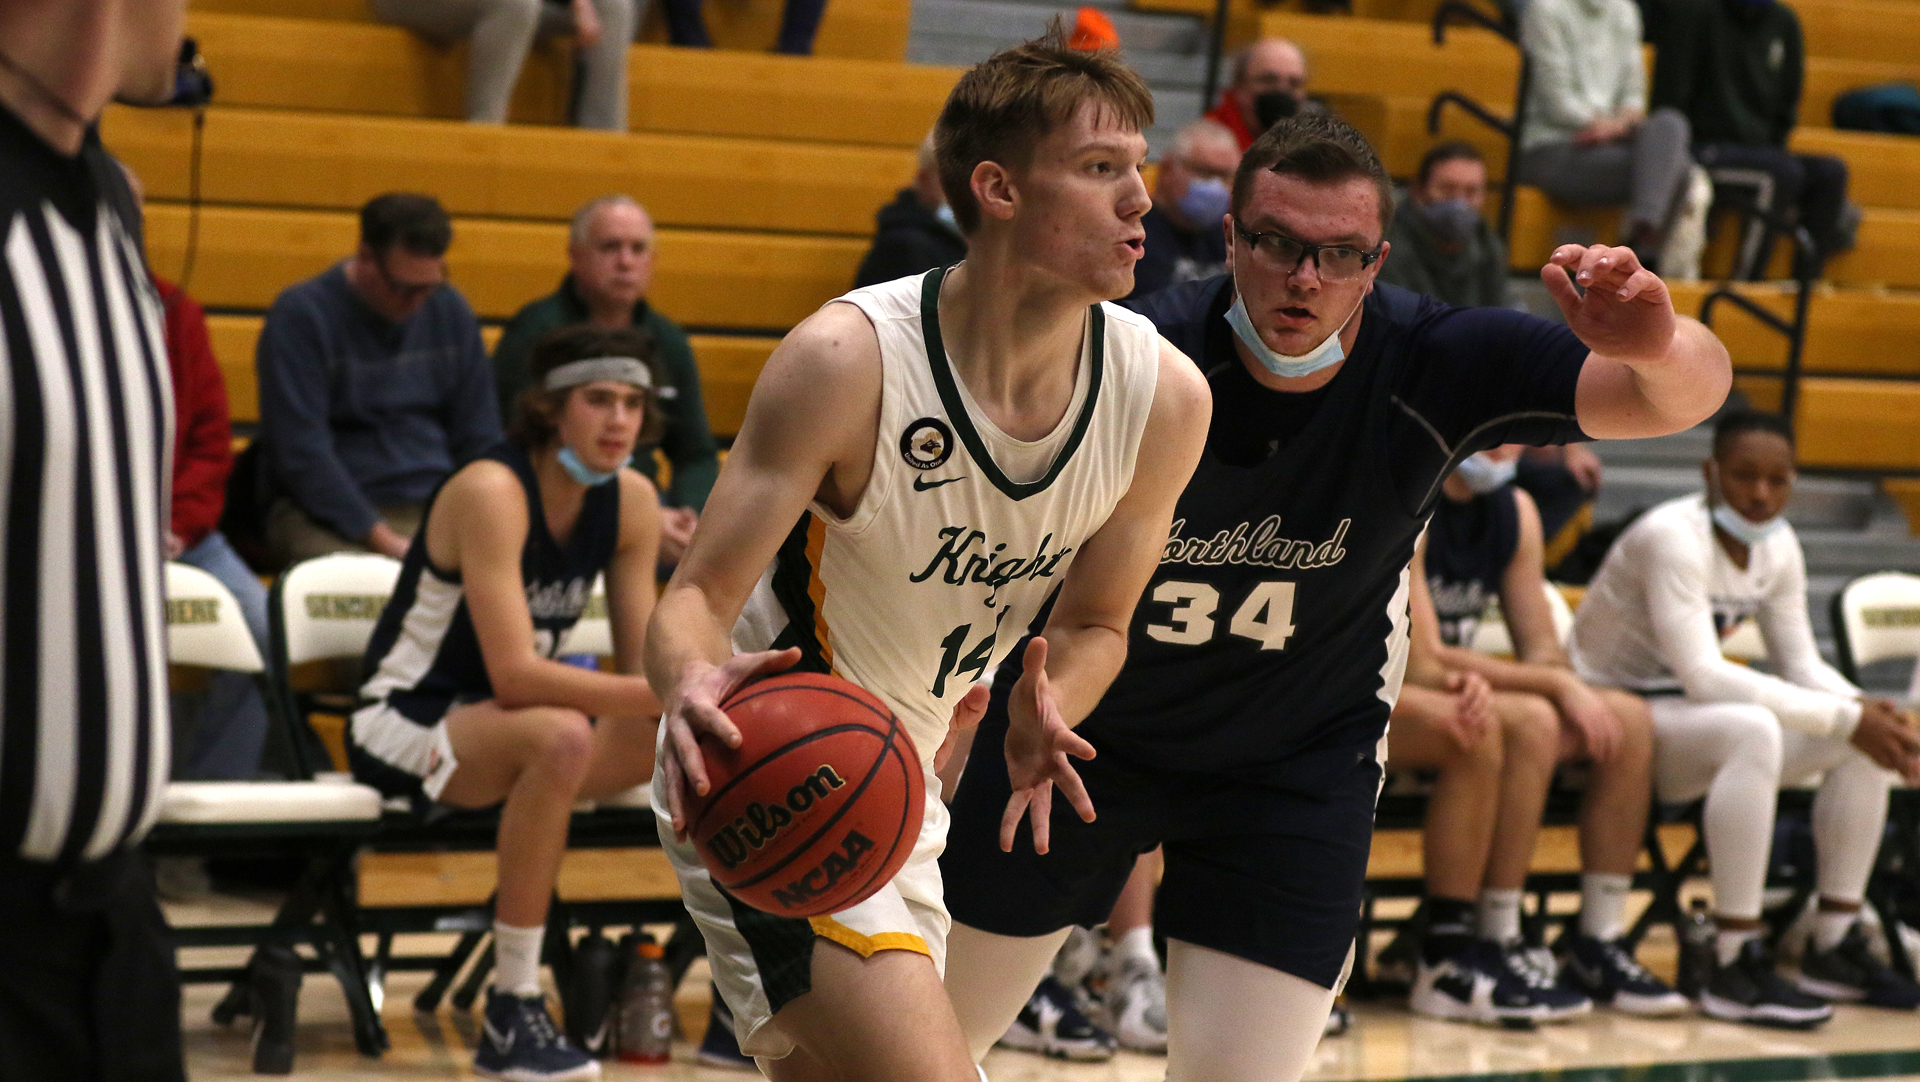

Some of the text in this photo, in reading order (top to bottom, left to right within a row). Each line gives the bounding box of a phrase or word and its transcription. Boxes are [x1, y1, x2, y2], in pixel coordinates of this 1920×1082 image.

[929, 459, 943, 468] One
[930, 604, 1011, 699] 14
[1146, 580, 1297, 651] 34
[705, 763, 846, 869] Wilson
[771, 829, 875, 908] NCAA
